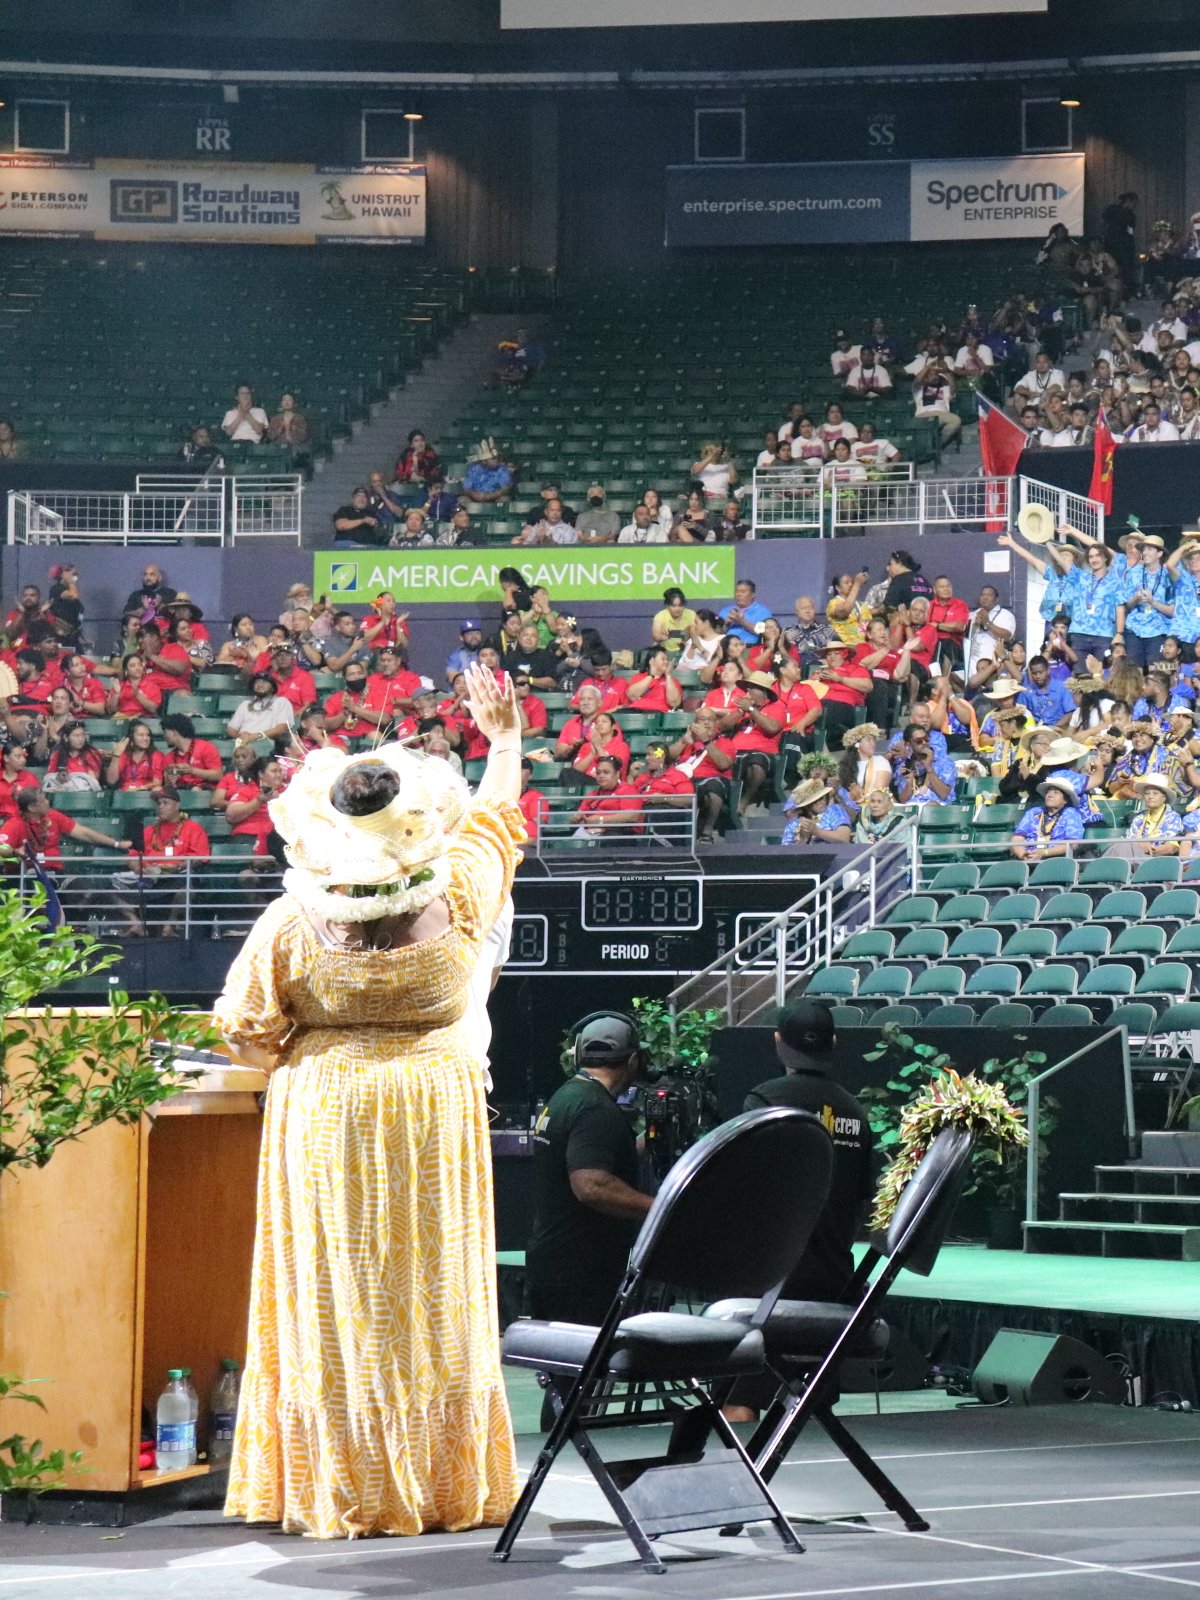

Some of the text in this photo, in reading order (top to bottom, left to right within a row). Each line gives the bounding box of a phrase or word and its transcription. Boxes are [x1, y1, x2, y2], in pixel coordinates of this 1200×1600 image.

[196, 127, 232, 151] RR
[868, 123, 895, 146] SS
[11, 192, 88, 202] PETERSON
[121, 189, 167, 213] GP
[183, 182, 300, 209] Roadway
[351, 193, 420, 205] UNISTRUT
[927, 179, 1058, 210] Spectrum
[183, 204, 300, 224] Solutions
[361, 207, 411, 217] HAWAII
[683, 197, 882, 214] enterprise.spectrum.com
[964, 206, 1058, 221] ENTERPRISE
[520, 562, 633, 586] SAVINGS
[643, 561, 720, 585] BANK
[601, 944, 650, 959] PERIOD
